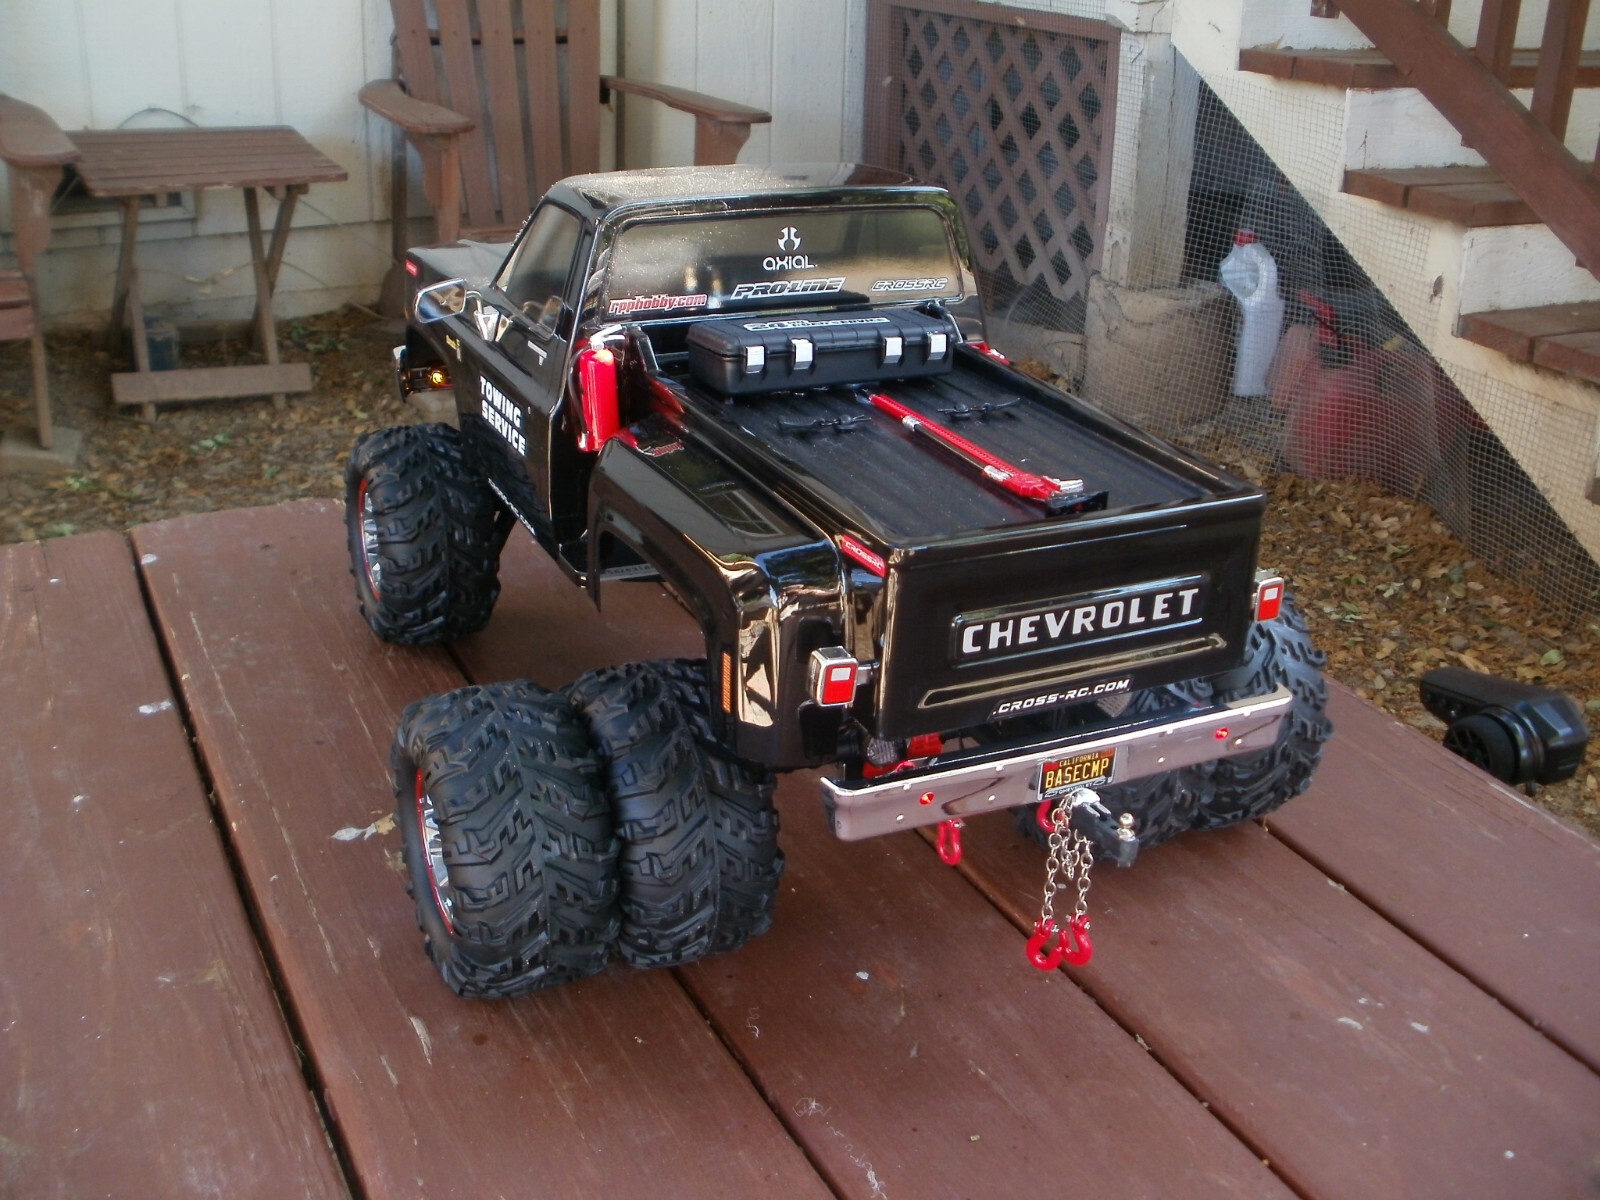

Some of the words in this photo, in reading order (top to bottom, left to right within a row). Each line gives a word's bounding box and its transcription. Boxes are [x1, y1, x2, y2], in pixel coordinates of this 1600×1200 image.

[871, 278, 948, 292] CROSSRC
[609, 294, 708, 315] rpphobby.com
[480, 375, 522, 428] TOWING
[481, 400, 526, 456] SERVICE
[962, 588, 1199, 654] CHEVROLET
[1045, 758, 1110, 789] BASECMP
[1060, 752, 1099, 767] CALIFORNIA
